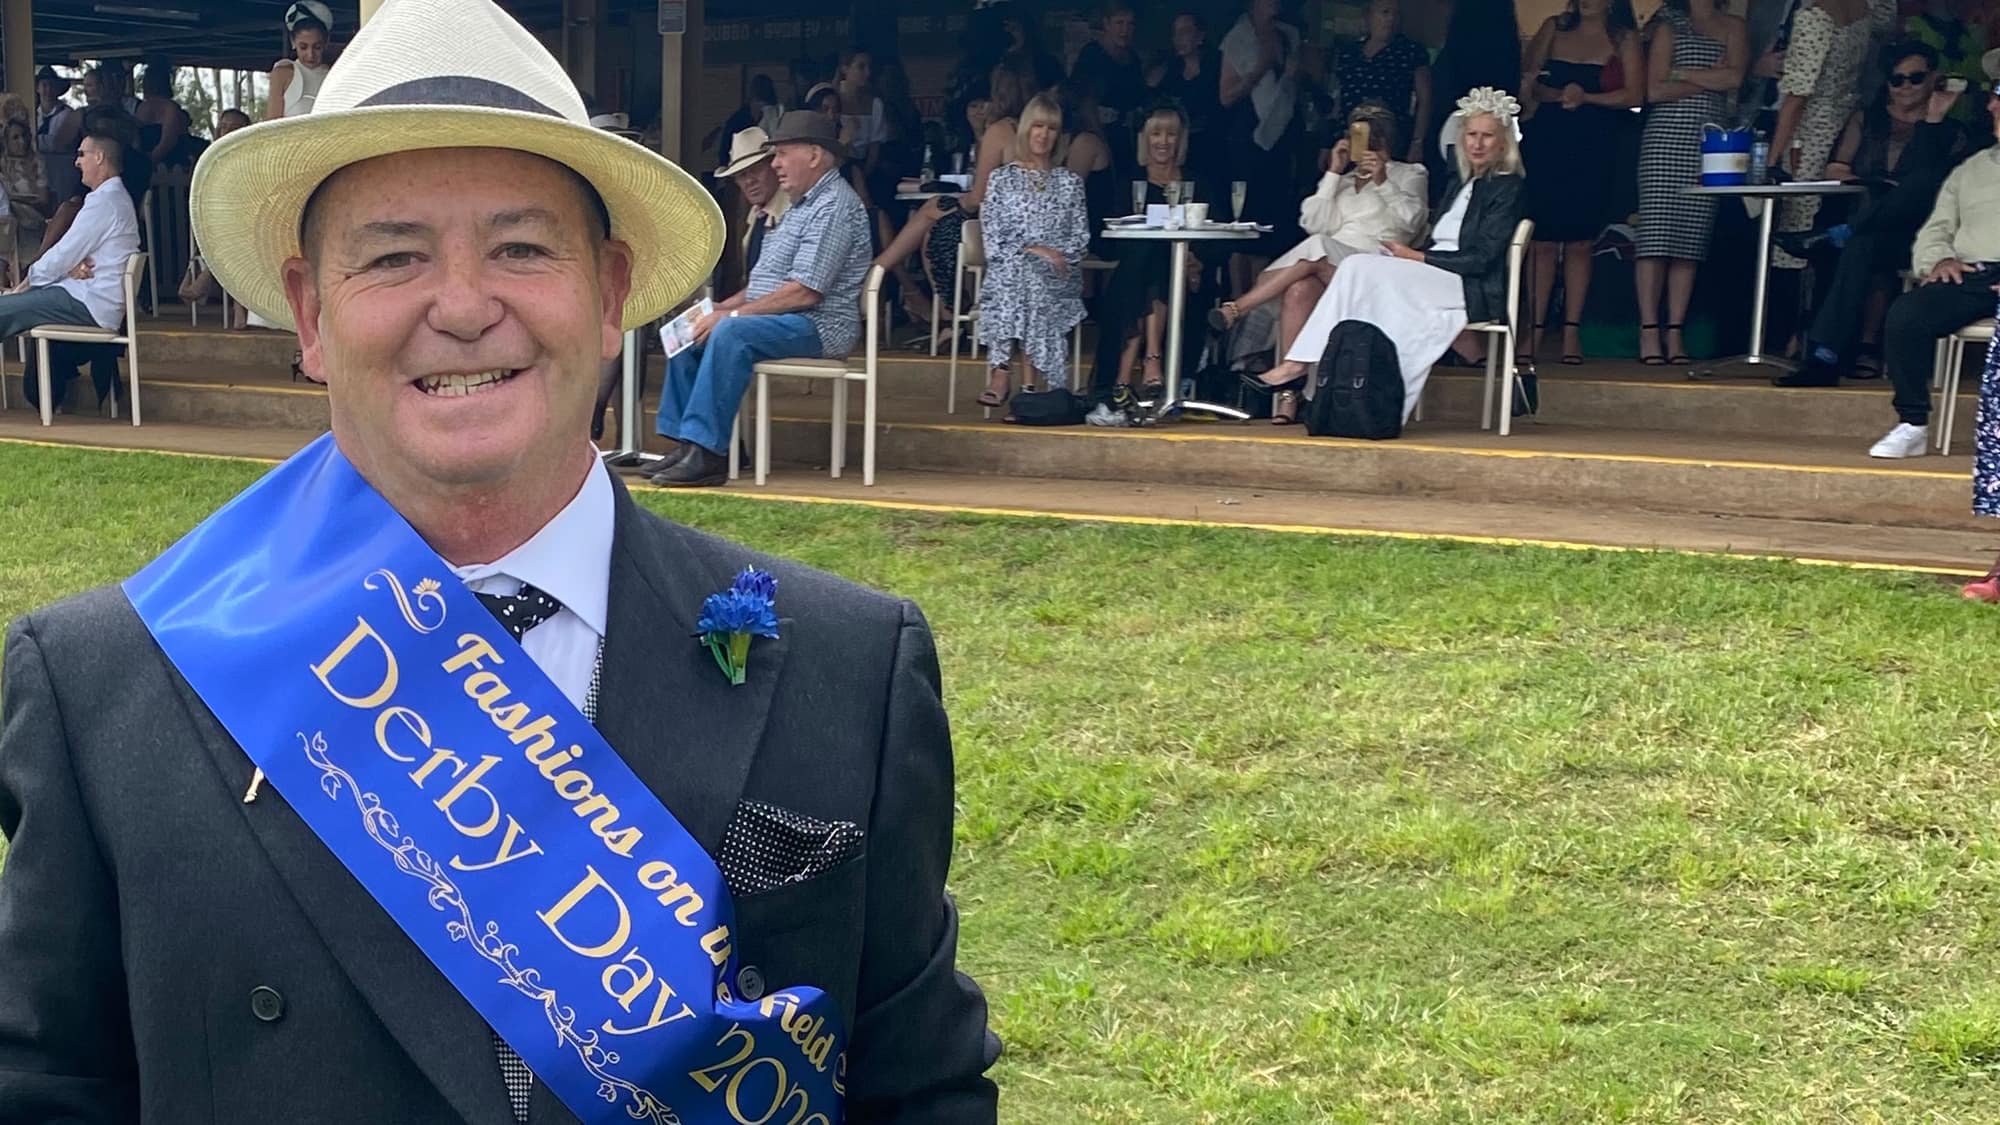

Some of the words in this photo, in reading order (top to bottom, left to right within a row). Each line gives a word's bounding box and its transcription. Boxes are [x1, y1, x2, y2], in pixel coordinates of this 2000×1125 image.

[309, 615, 545, 872] Derby
[535, 864, 698, 1036] Day
[441, 633, 644, 858] Fashions
[637, 860, 704, 927] on
[759, 993, 836, 1073] Field
